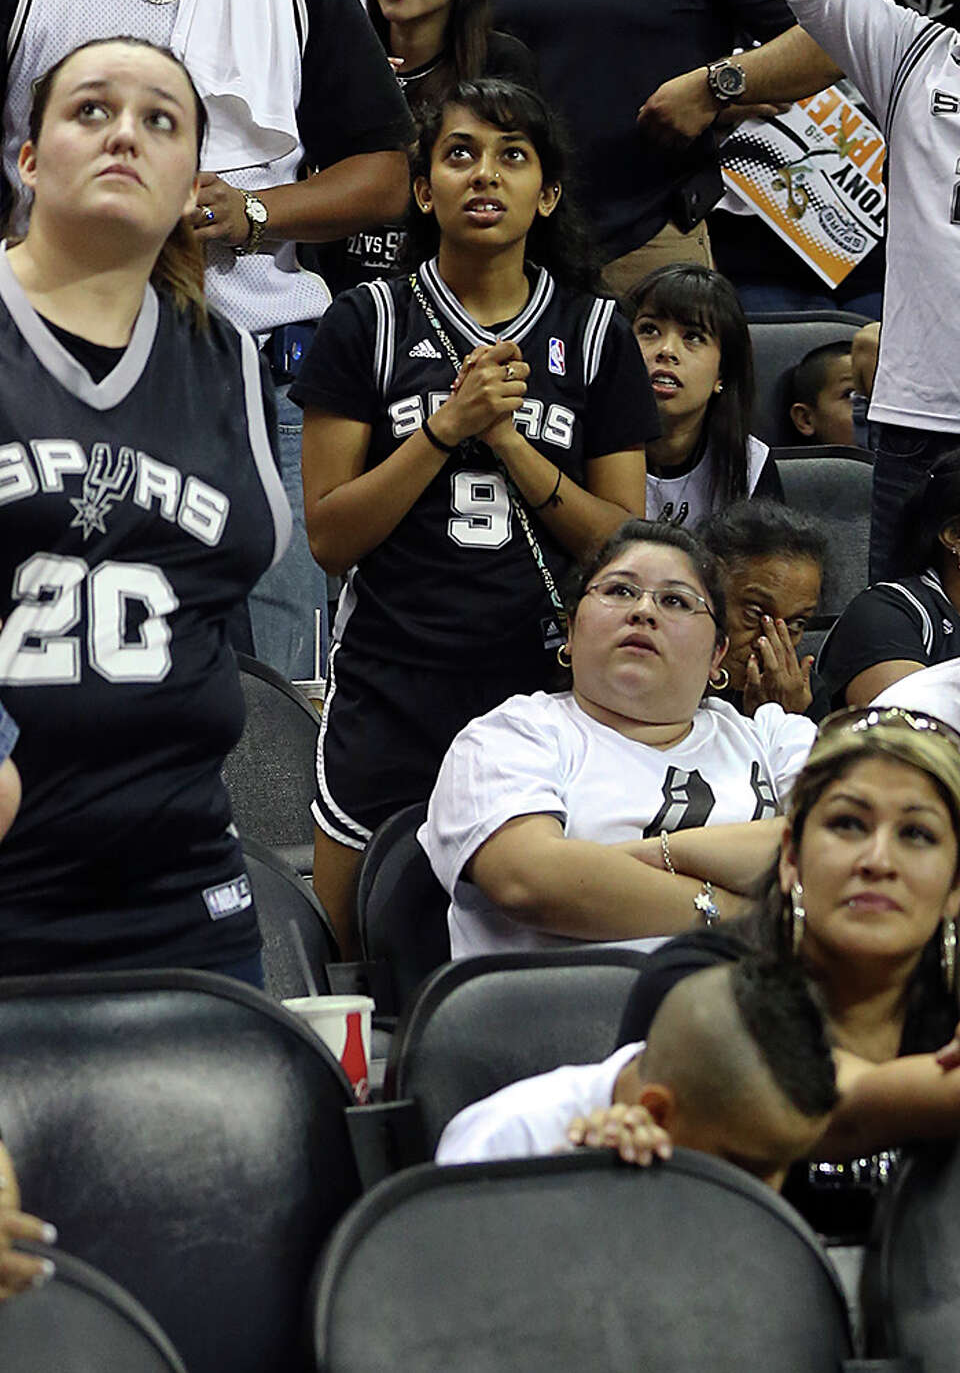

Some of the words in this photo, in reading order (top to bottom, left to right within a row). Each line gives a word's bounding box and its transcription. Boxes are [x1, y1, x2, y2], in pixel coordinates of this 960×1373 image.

[830, 163, 886, 228] TONY
[408, 350, 443, 360] adidas
[388, 390, 576, 450] SPRS
[0, 438, 231, 547] SPURS
[447, 469, 513, 550] 9
[0, 551, 180, 686] 20
